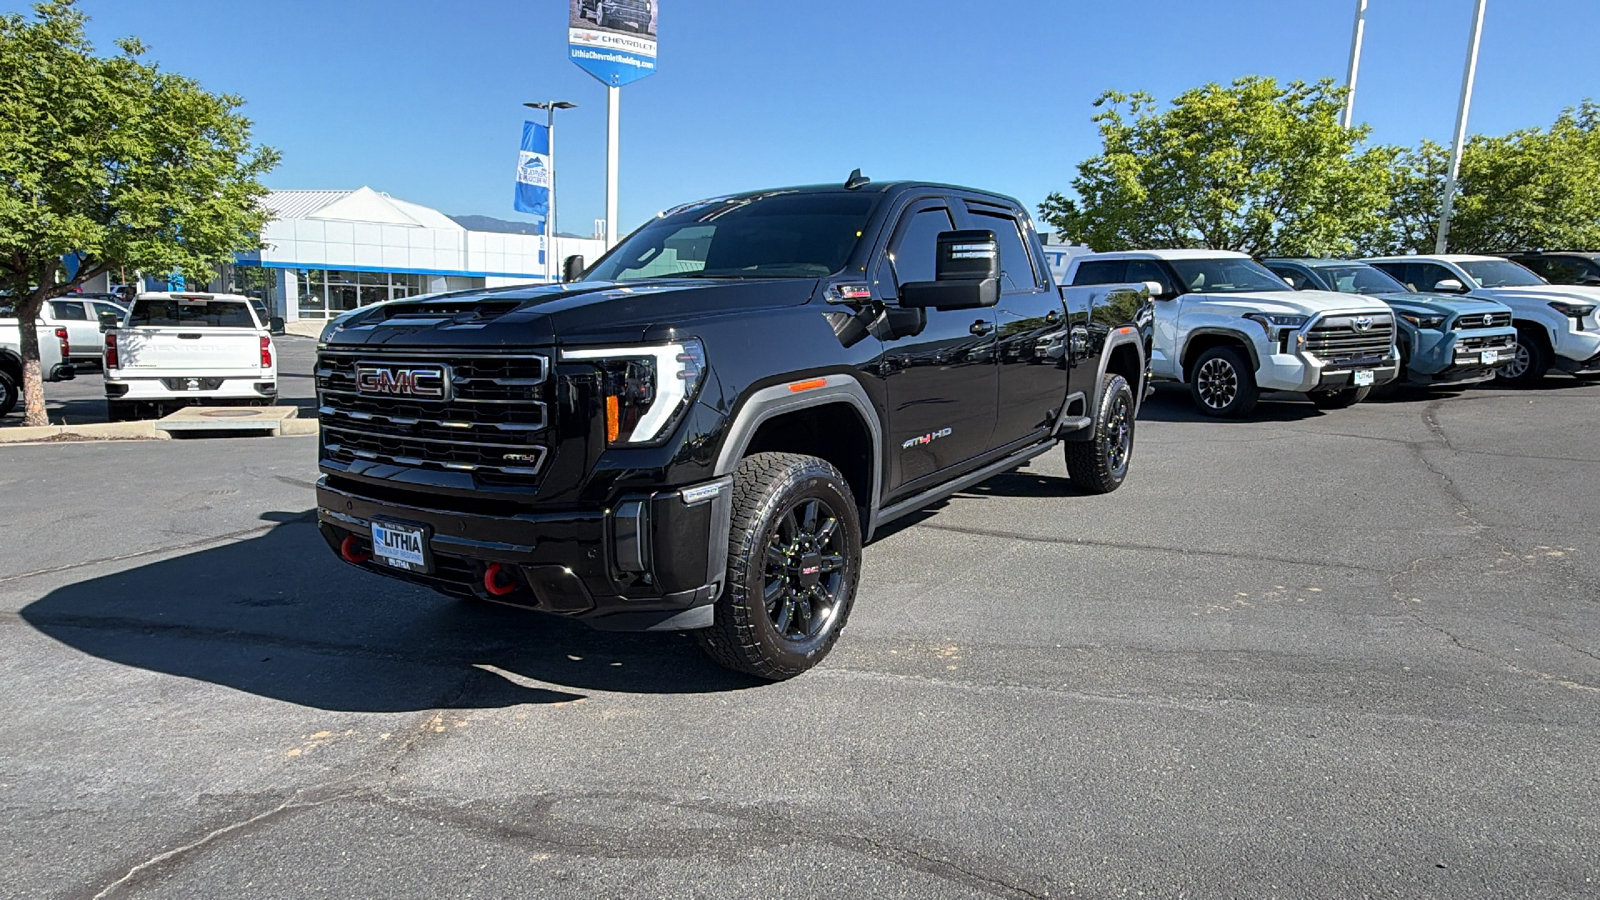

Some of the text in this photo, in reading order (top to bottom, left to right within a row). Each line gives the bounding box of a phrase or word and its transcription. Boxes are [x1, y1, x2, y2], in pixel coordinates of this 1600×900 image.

[602, 36, 653, 50] CHEVROLET
[357, 368, 442, 396] GMC
[384, 530, 421, 553] LITHIA
